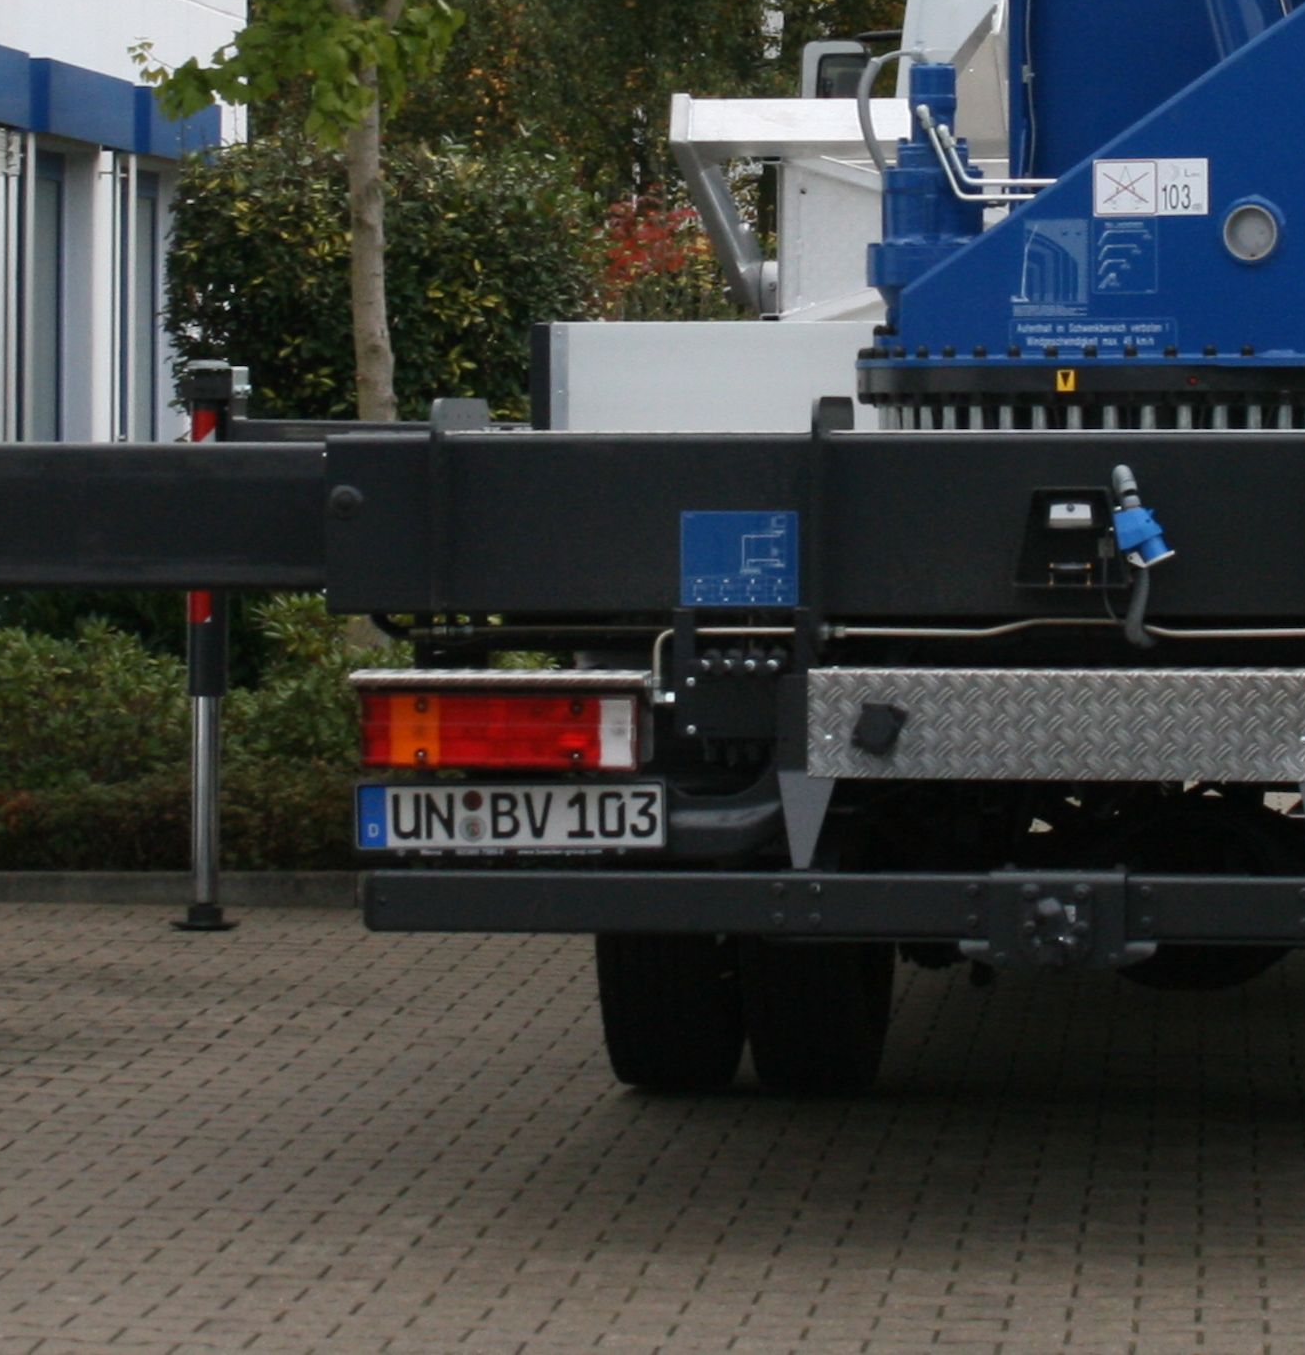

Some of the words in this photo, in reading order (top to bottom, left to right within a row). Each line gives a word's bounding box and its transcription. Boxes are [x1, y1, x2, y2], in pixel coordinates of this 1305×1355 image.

[1161, 184, 1192, 211] 103
[392, 792, 455, 840] UN
[491, 792, 552, 839] BV
[567, 792, 658, 839] 103
[367, 822, 380, 839] D
